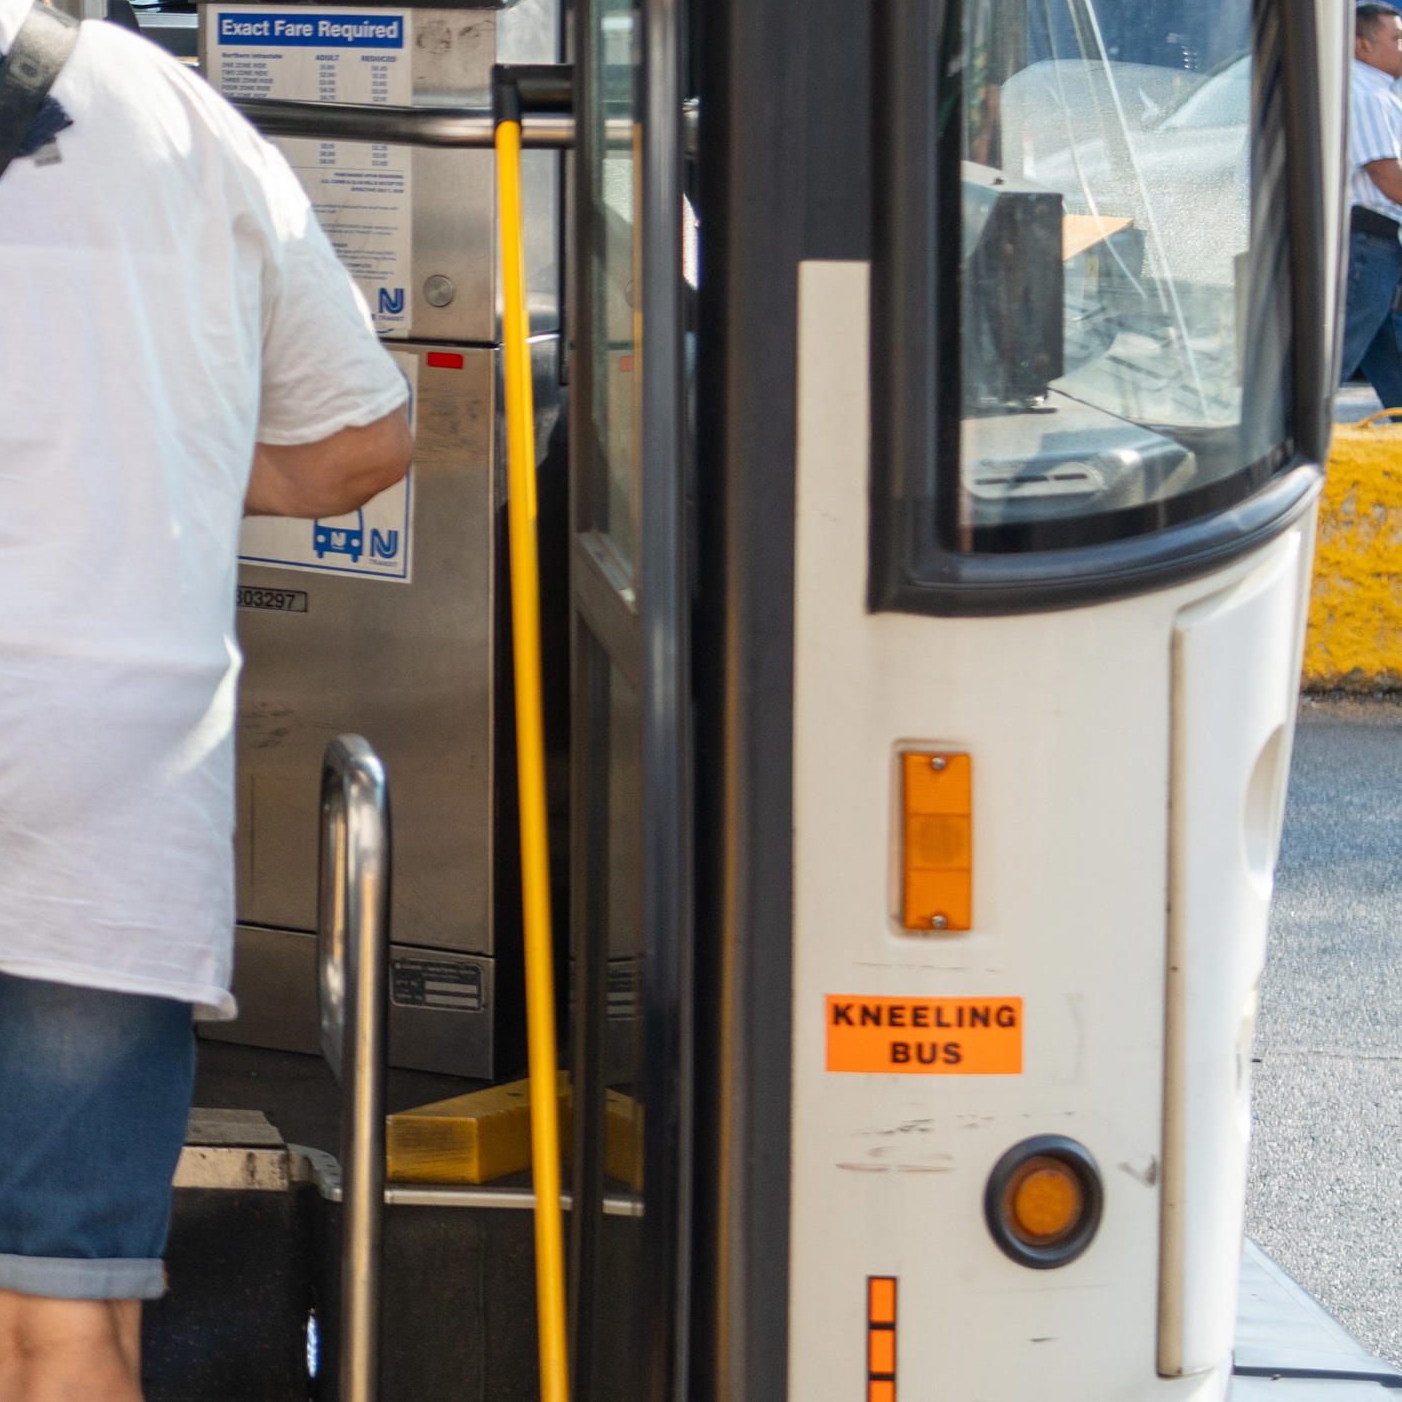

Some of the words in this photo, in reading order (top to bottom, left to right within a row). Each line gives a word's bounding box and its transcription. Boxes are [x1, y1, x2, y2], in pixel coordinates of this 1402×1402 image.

[221, 19, 269, 36] Exact
[274, 20, 313, 37] Fare
[318, 20, 398, 41] Required
[832, 1003, 1017, 1028] KNEELING
[889, 1042, 963, 1065] BUS
